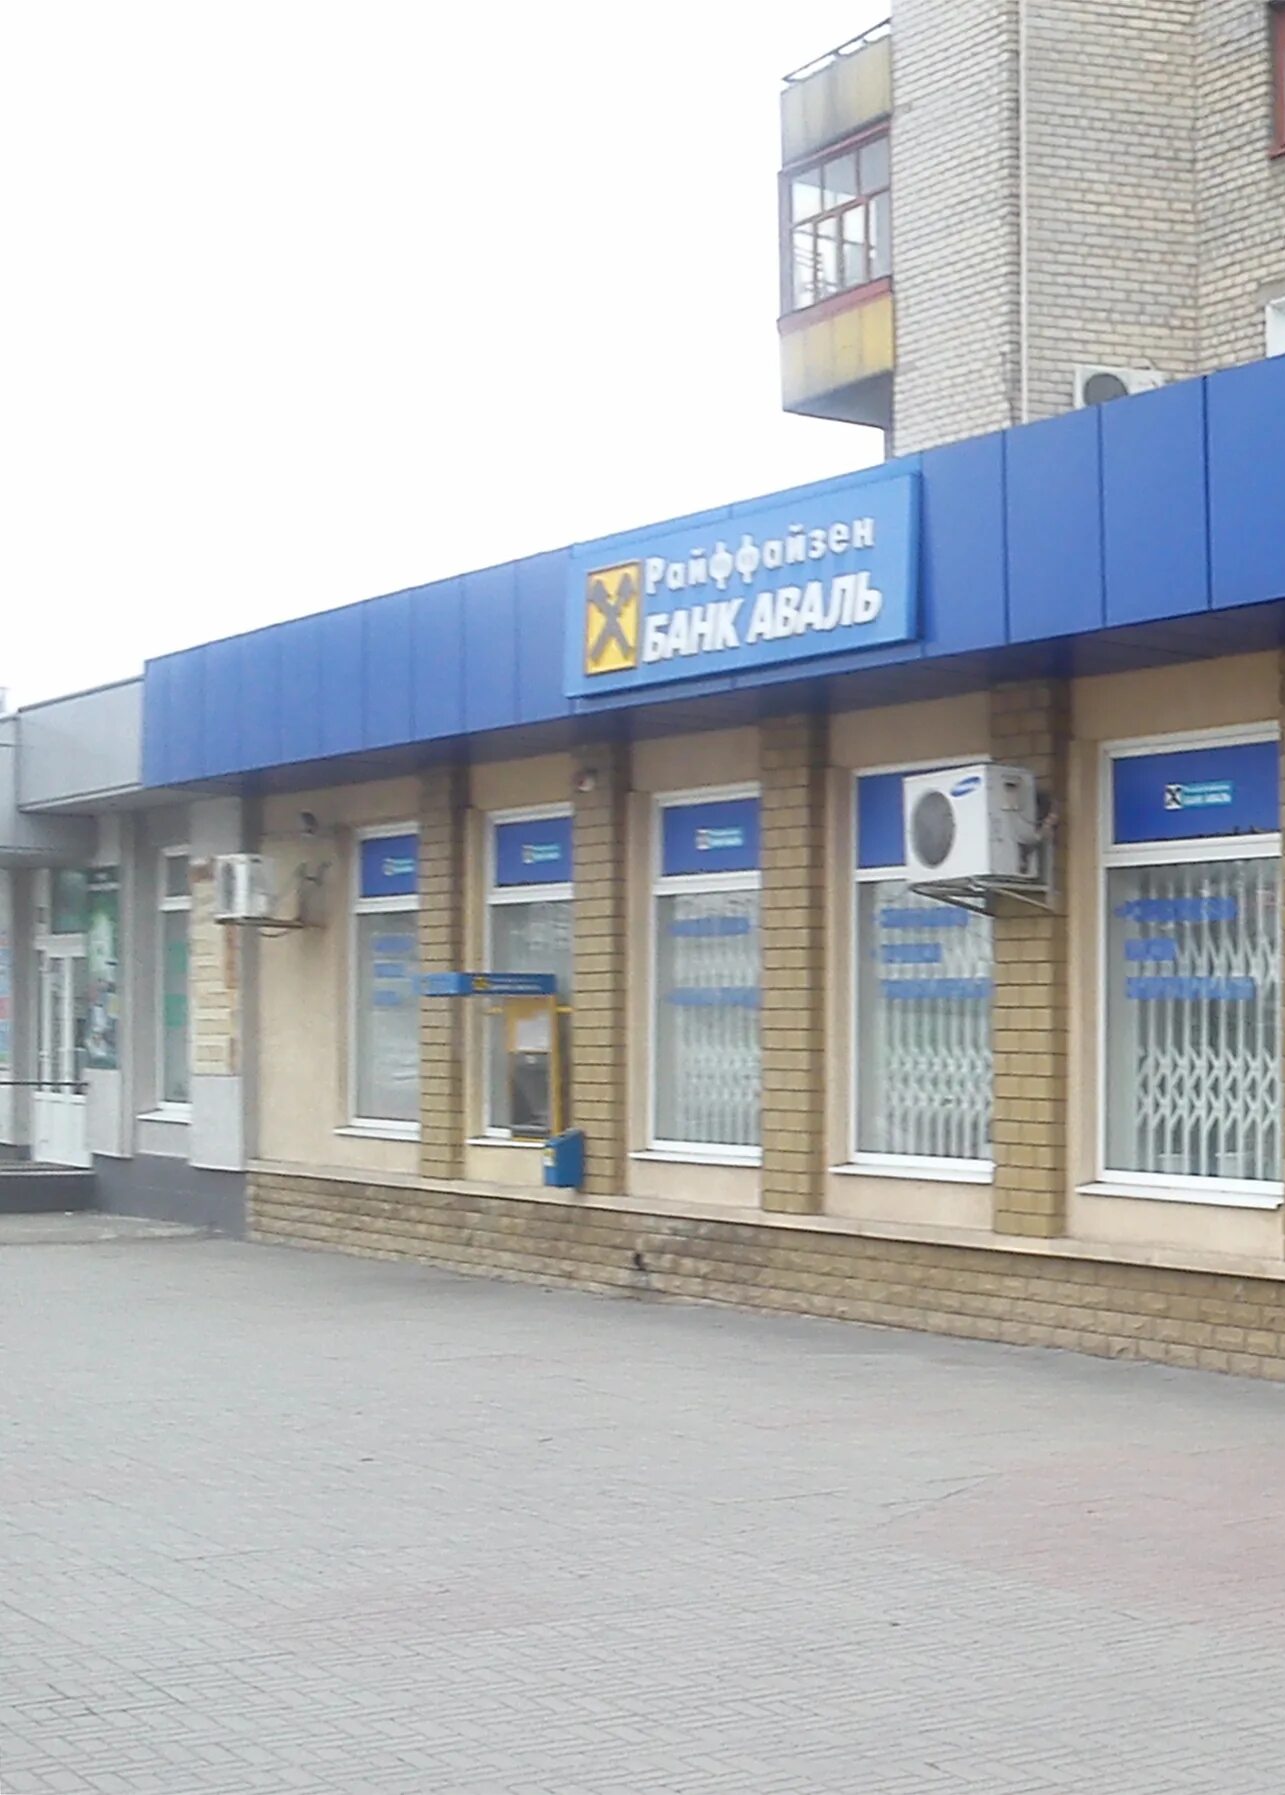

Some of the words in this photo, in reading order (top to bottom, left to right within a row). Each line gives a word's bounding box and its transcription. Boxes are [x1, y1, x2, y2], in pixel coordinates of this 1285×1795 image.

[644, 516, 876, 596] Райффайзен
[641, 597, 744, 664] БАНК
[745, 570, 883, 644] АВАЛЬ
